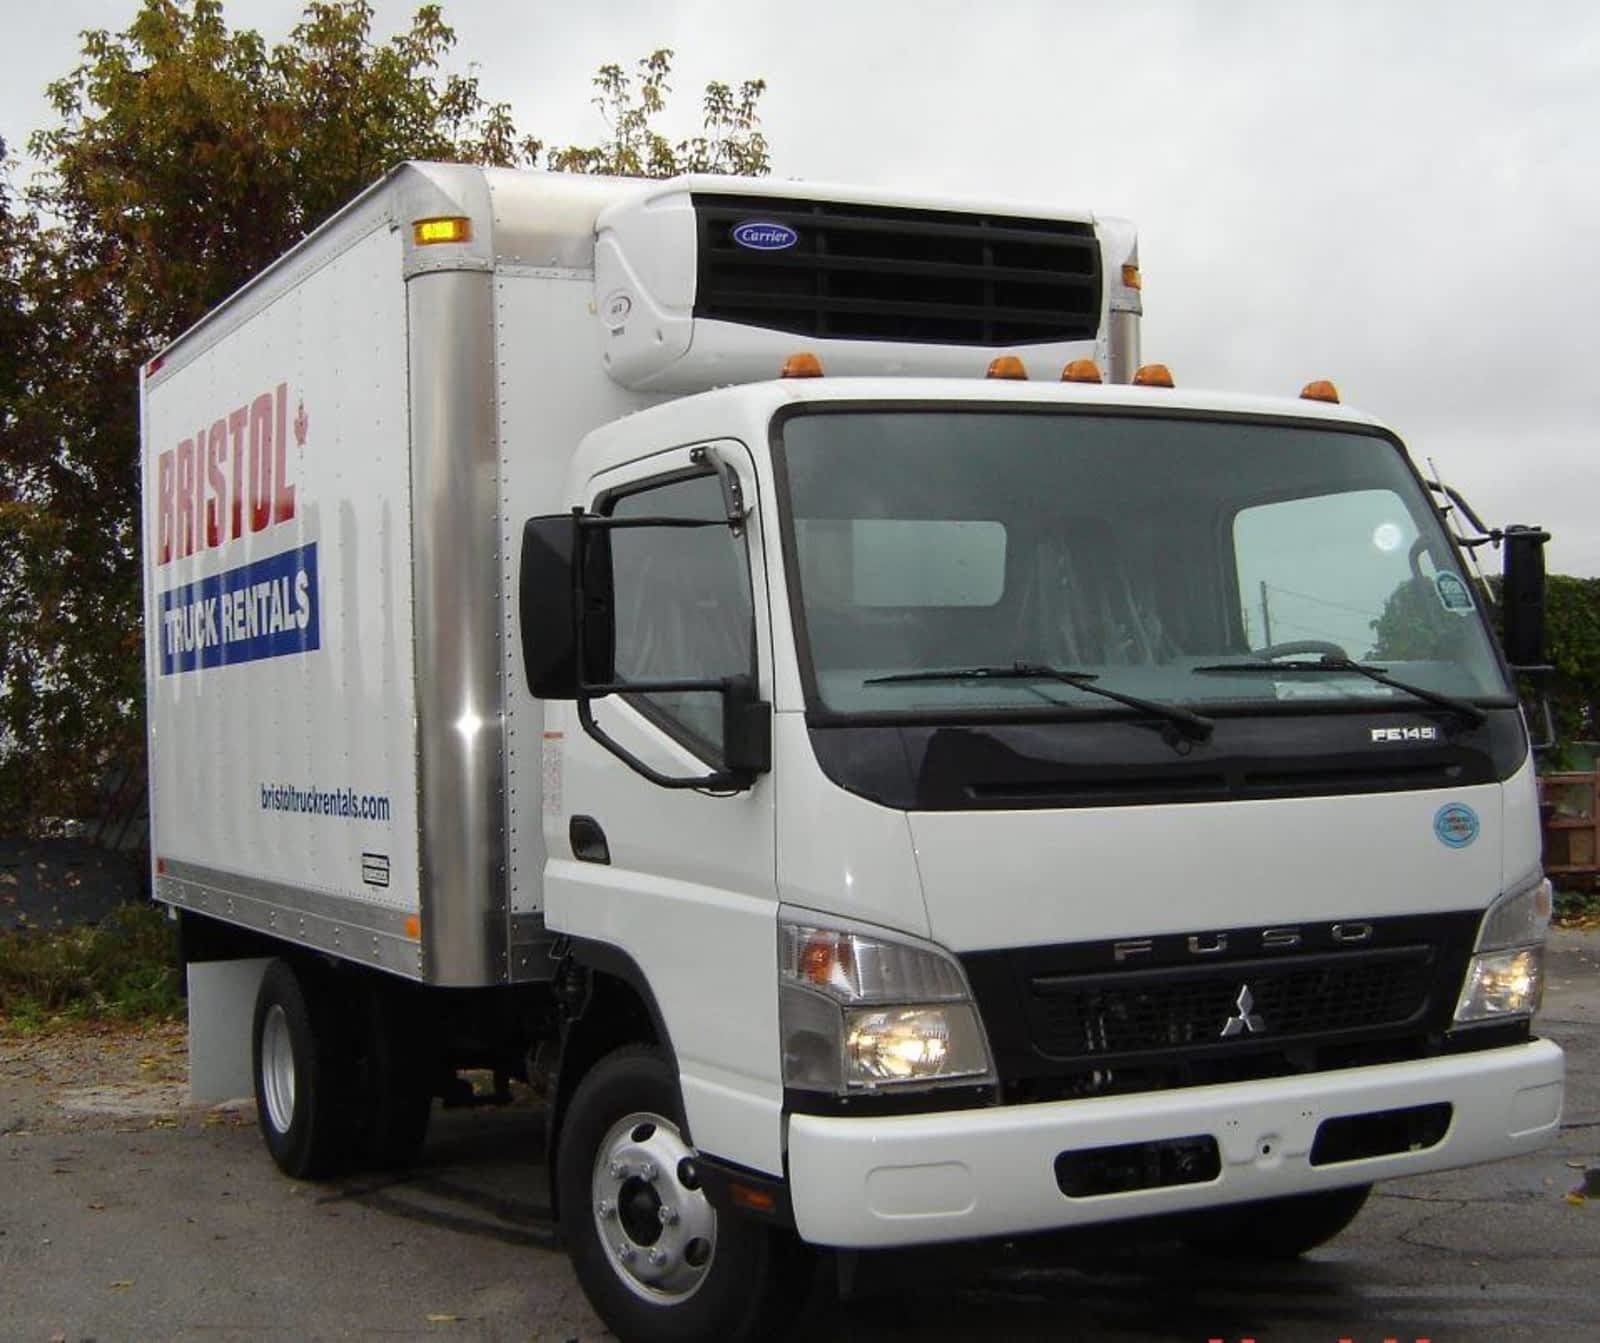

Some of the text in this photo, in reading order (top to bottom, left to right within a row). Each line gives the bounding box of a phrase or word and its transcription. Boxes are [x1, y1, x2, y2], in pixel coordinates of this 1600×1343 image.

[742, 228, 789, 242] Carrier
[158, 382, 295, 566] BRISTOL
[164, 569, 310, 655] TRUCK RENTALS
[261, 784, 390, 821] bristoltruckrentals.com
[1114, 923, 1373, 961] FUSO
